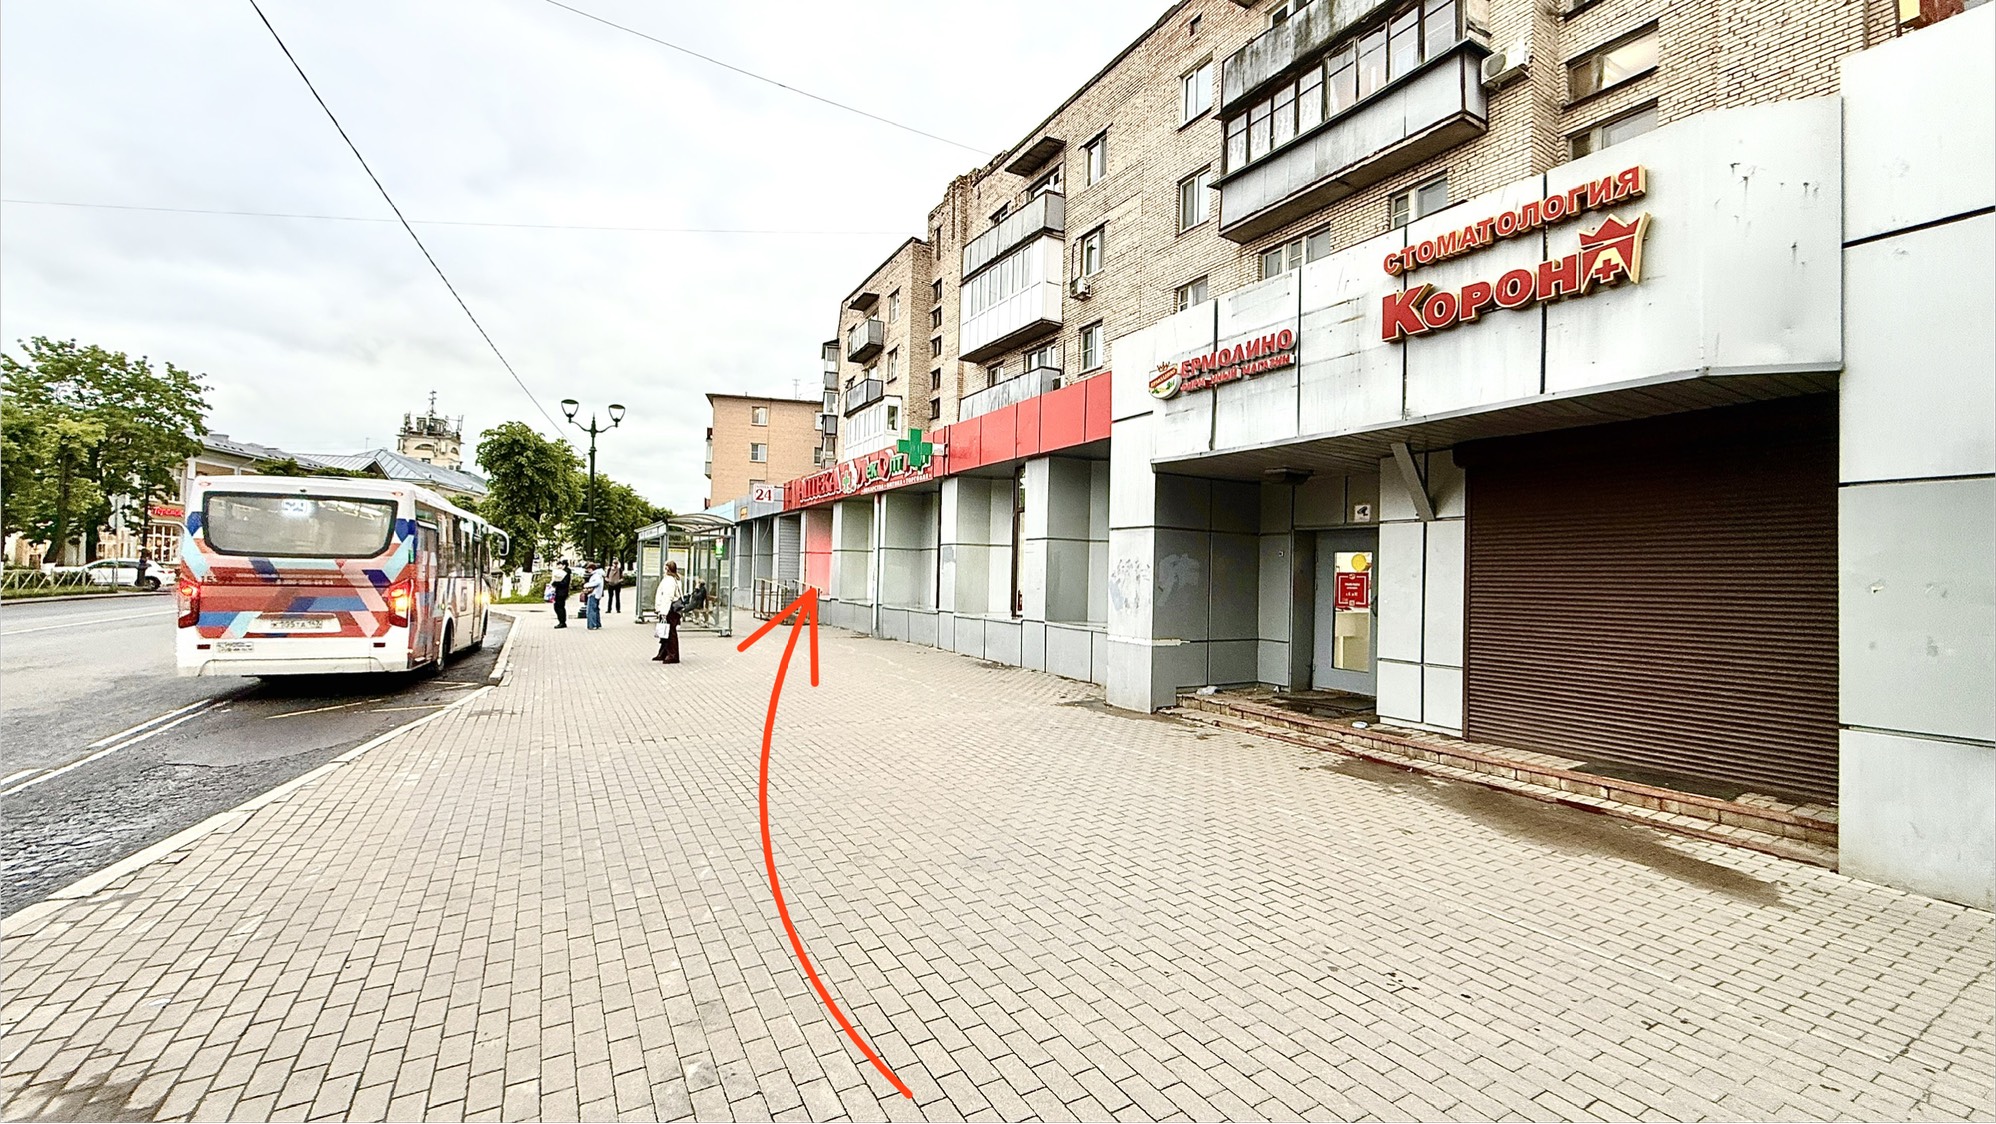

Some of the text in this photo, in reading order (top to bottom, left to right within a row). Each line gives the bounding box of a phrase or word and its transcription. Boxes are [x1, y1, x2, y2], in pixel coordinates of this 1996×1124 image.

[1384, 164, 1647, 277] СТОМАТОЛОГИЯ
[1382, 214, 1651, 343] КОРОНА
[1181, 328, 1296, 379] ЕРМОЛИНО
[1241, 354, 1294, 376] МАГАЗИН
[755, 488, 772, 501] 24
[800, 469, 841, 502] АПТЕКА
